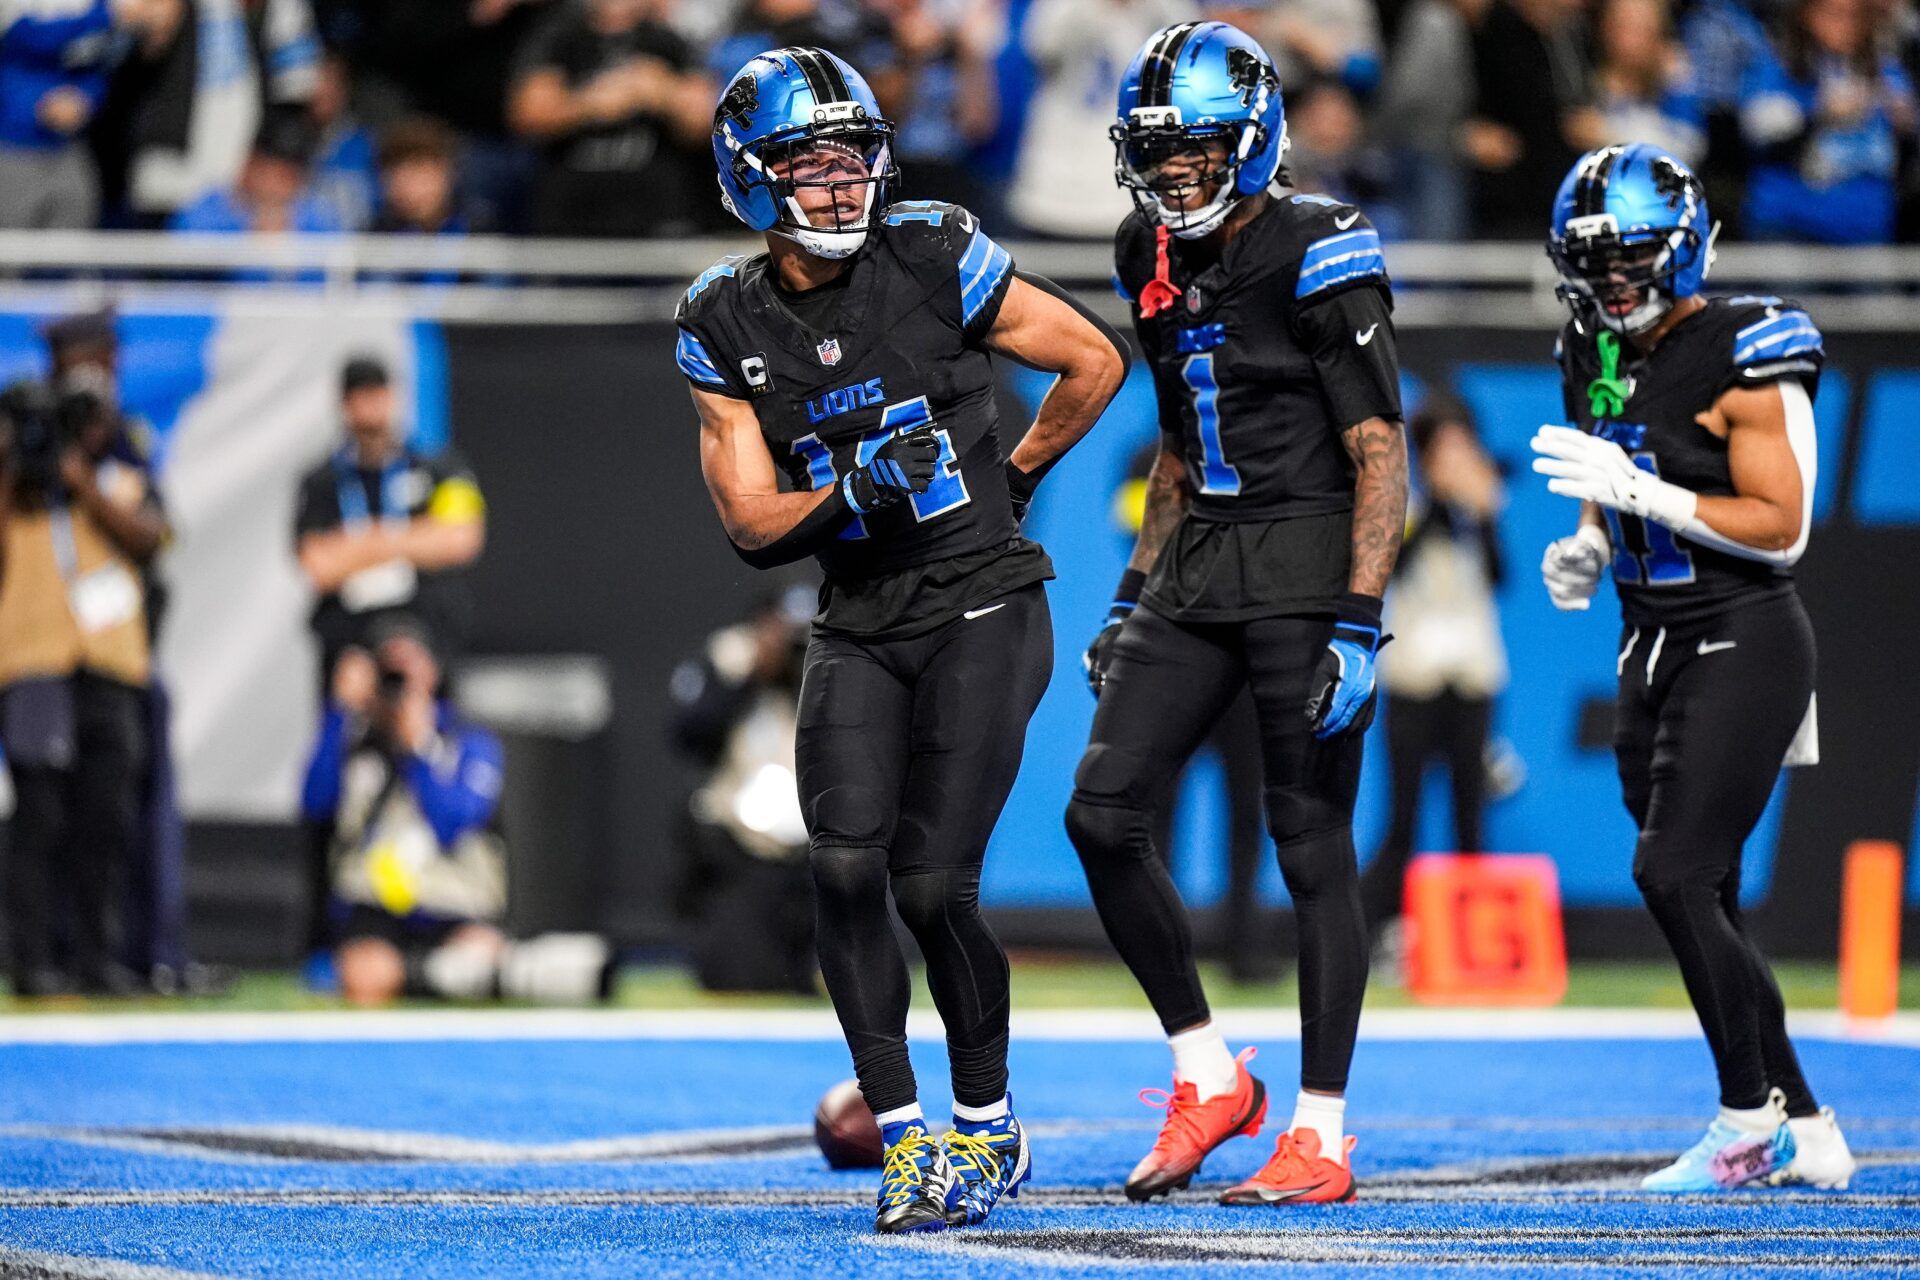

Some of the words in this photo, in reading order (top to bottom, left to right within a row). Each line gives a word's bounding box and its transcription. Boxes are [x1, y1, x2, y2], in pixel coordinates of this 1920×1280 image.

[741, 356, 767, 387] C
[806, 377, 886, 425] LIONS
[1182, 353, 1241, 496] 1
